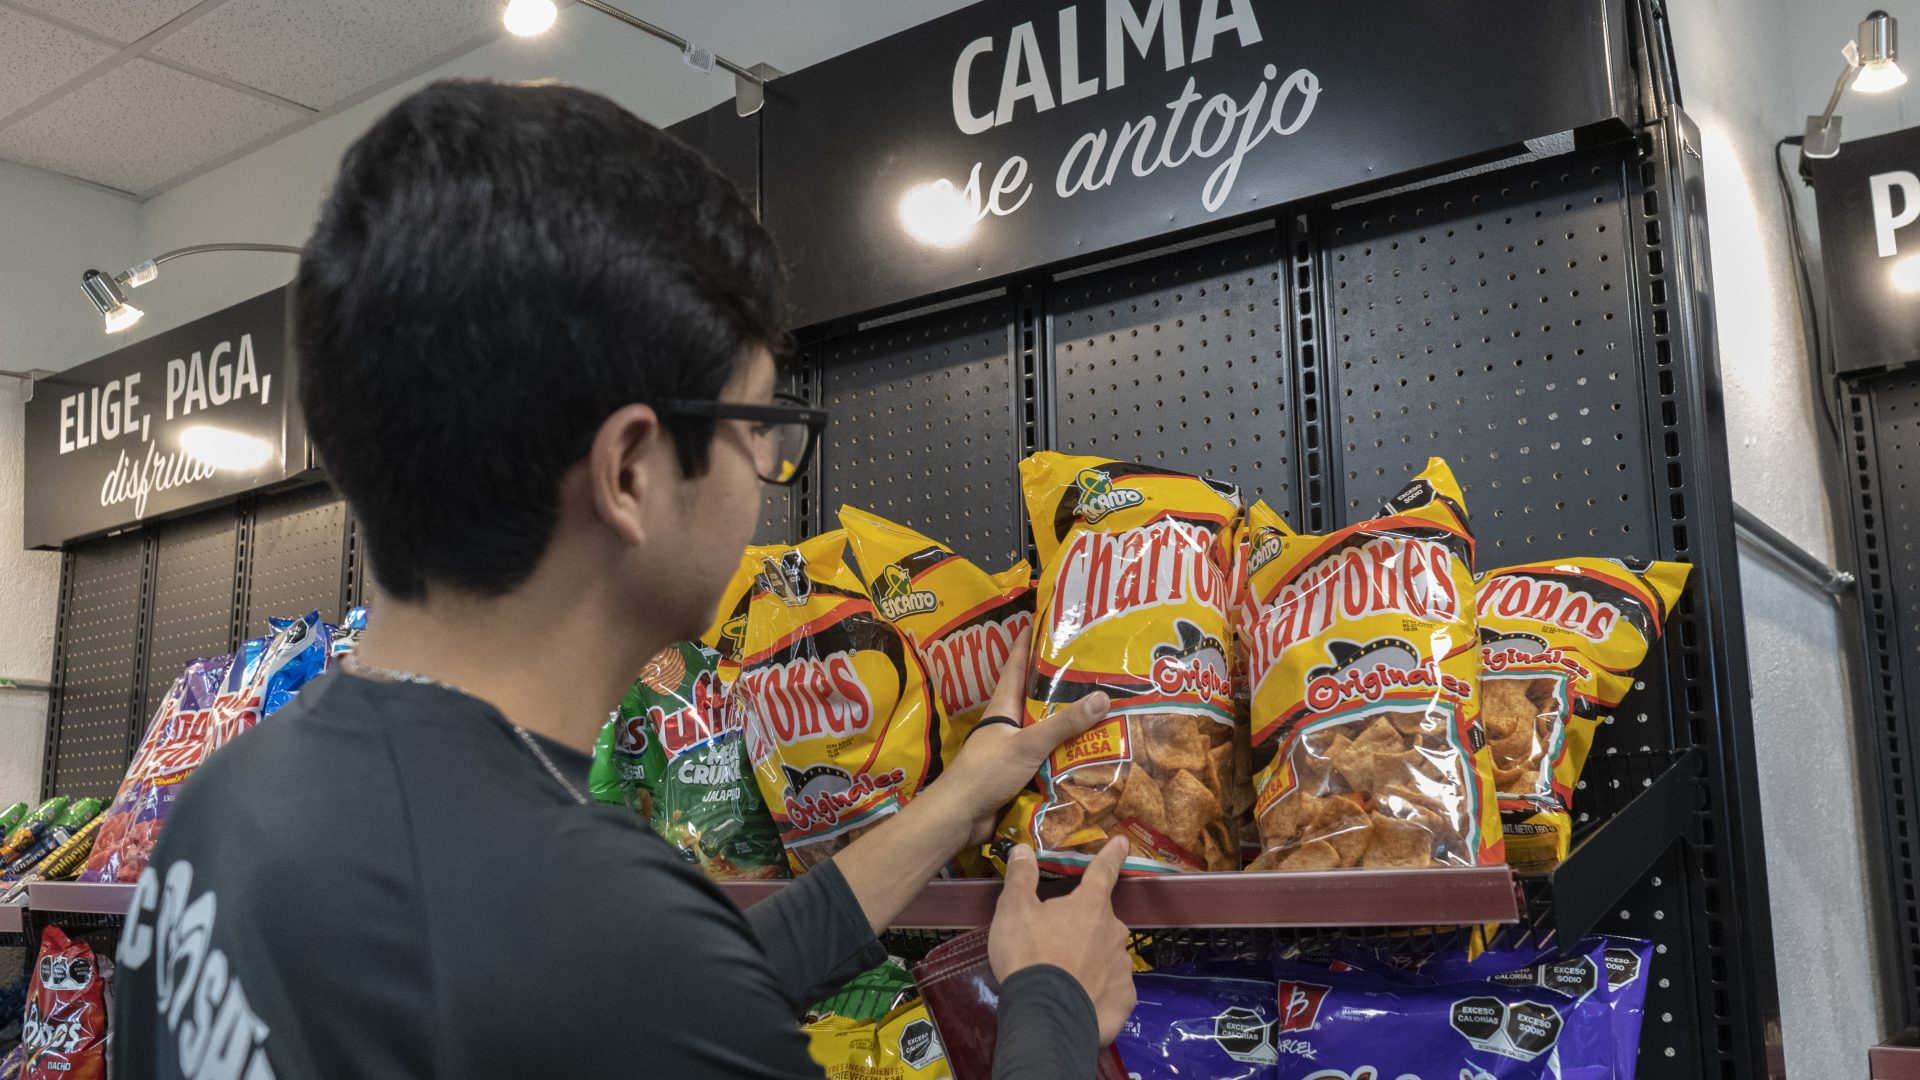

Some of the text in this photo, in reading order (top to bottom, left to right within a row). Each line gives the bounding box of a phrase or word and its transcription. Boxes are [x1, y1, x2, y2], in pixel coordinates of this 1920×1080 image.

[952, 0, 1263, 135] CALMA
[1055, 63, 1322, 212] antojo
[59, 333, 272, 455] ELIGE, PAGA,
[1396, 484, 1422, 501] EXCESO
[1403, 489, 1424, 504] SODIO
[1074, 487, 1143, 520] NCANTO
[882, 591, 937, 619] ENCANTO
[1306, 663, 1471, 710] Originales
[1065, 740, 1112, 761] SALSA
[786, 768, 905, 829] Originales
[1553, 966, 1586, 976] EXCESO
[1557, 974, 1582, 984] SODIO
[1458, 1013, 1498, 1025] CALORÍAS
[1462, 1006, 1495, 1016] EXCESO
[1517, 1013, 1551, 1030] EXCESO
[1518, 1023, 1546, 1037] SODIO
[907, 1032, 929, 1046] EXCESO
[48, 1061, 71, 1071] NACHO
